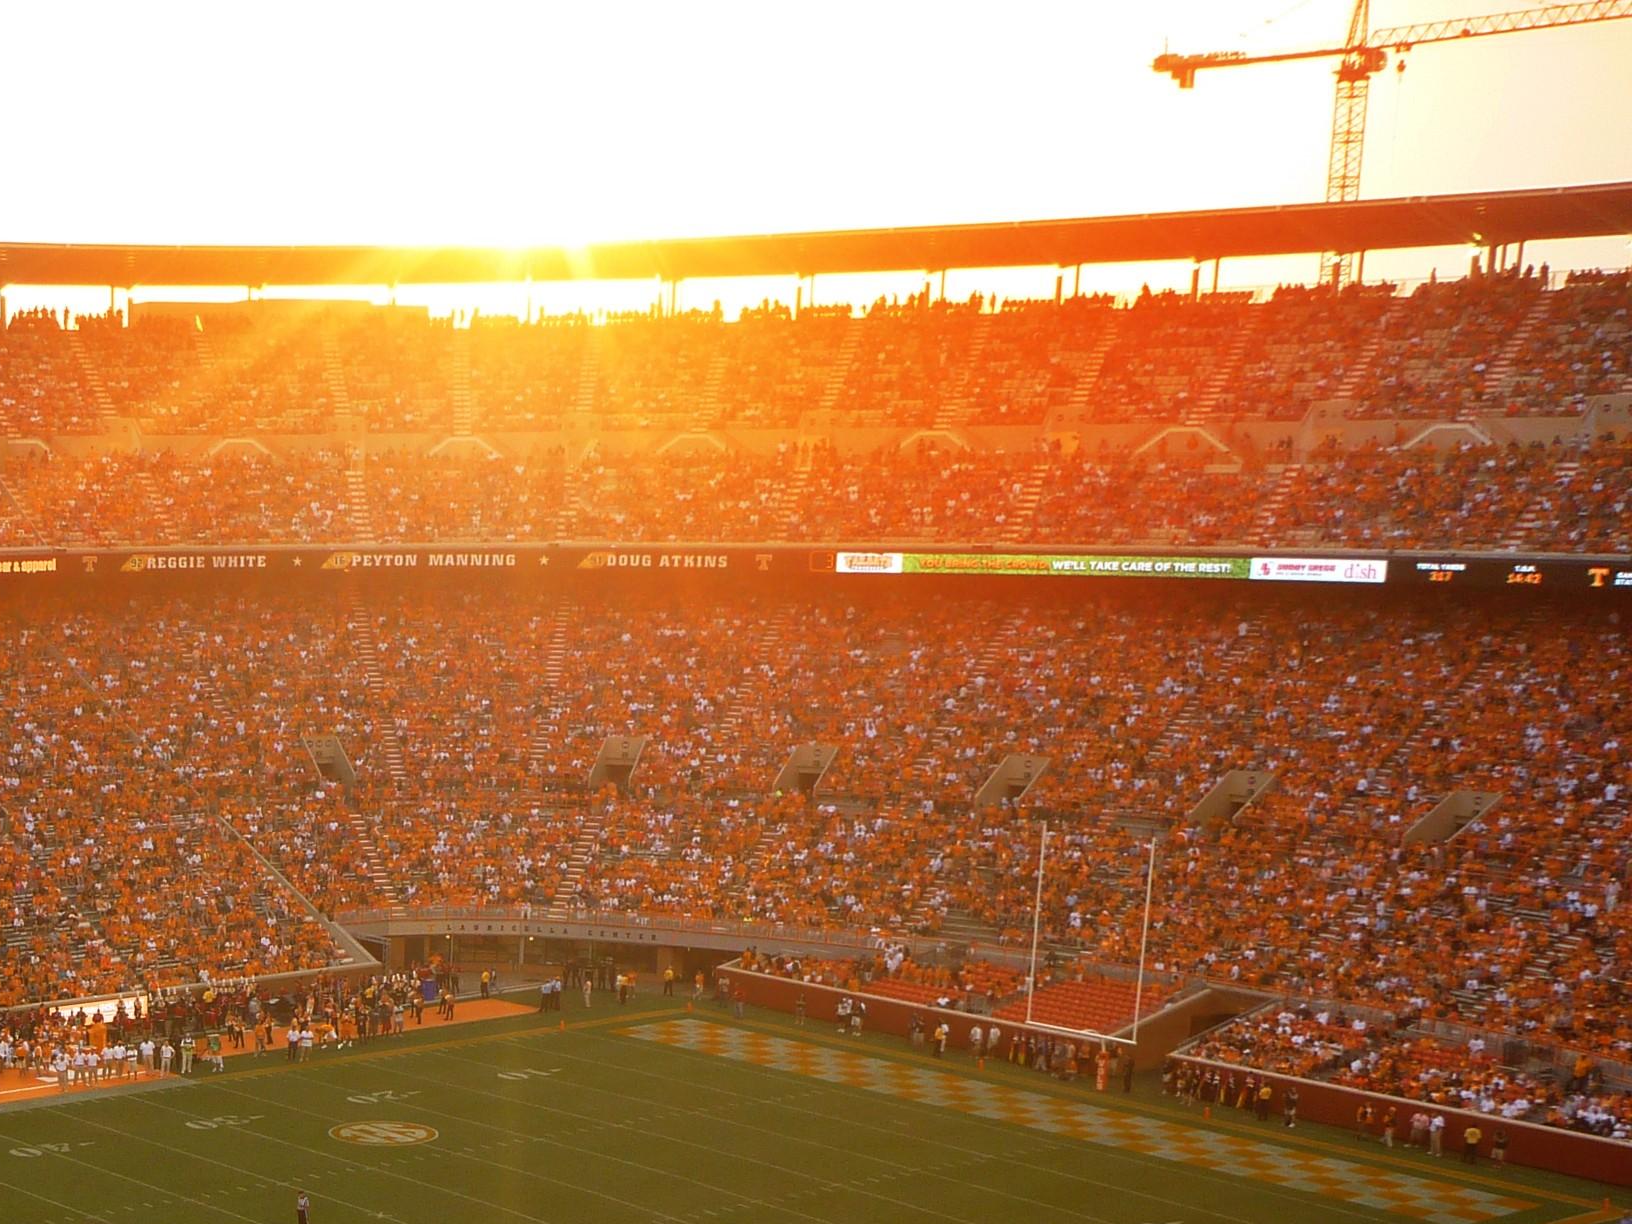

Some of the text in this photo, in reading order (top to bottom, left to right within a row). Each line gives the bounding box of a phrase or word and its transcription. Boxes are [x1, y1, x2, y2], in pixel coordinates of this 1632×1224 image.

[21, 558, 56, 575] apparel
[146, 556, 205, 569] REGGIE
[212, 555, 267, 568] WHITE
[351, 554, 418, 567] PEYTON
[429, 553, 516, 567] MANNING
[607, 553, 652, 567] DOUG
[659, 554, 728, 568] ATKINS
[920, 558, 943, 568] YOU
[980, 558, 1003, 569] THE
[1052, 560, 1086, 570] WE'LL
[1089, 561, 1119, 571] TAKE
[1121, 561, 1152, 571] CARE
[1154, 562, 1170, 572] OF
[1173, 562, 1196, 572] THE
[1198, 562, 1231, 574] REST!
[1588, 567, 1610, 587] T
